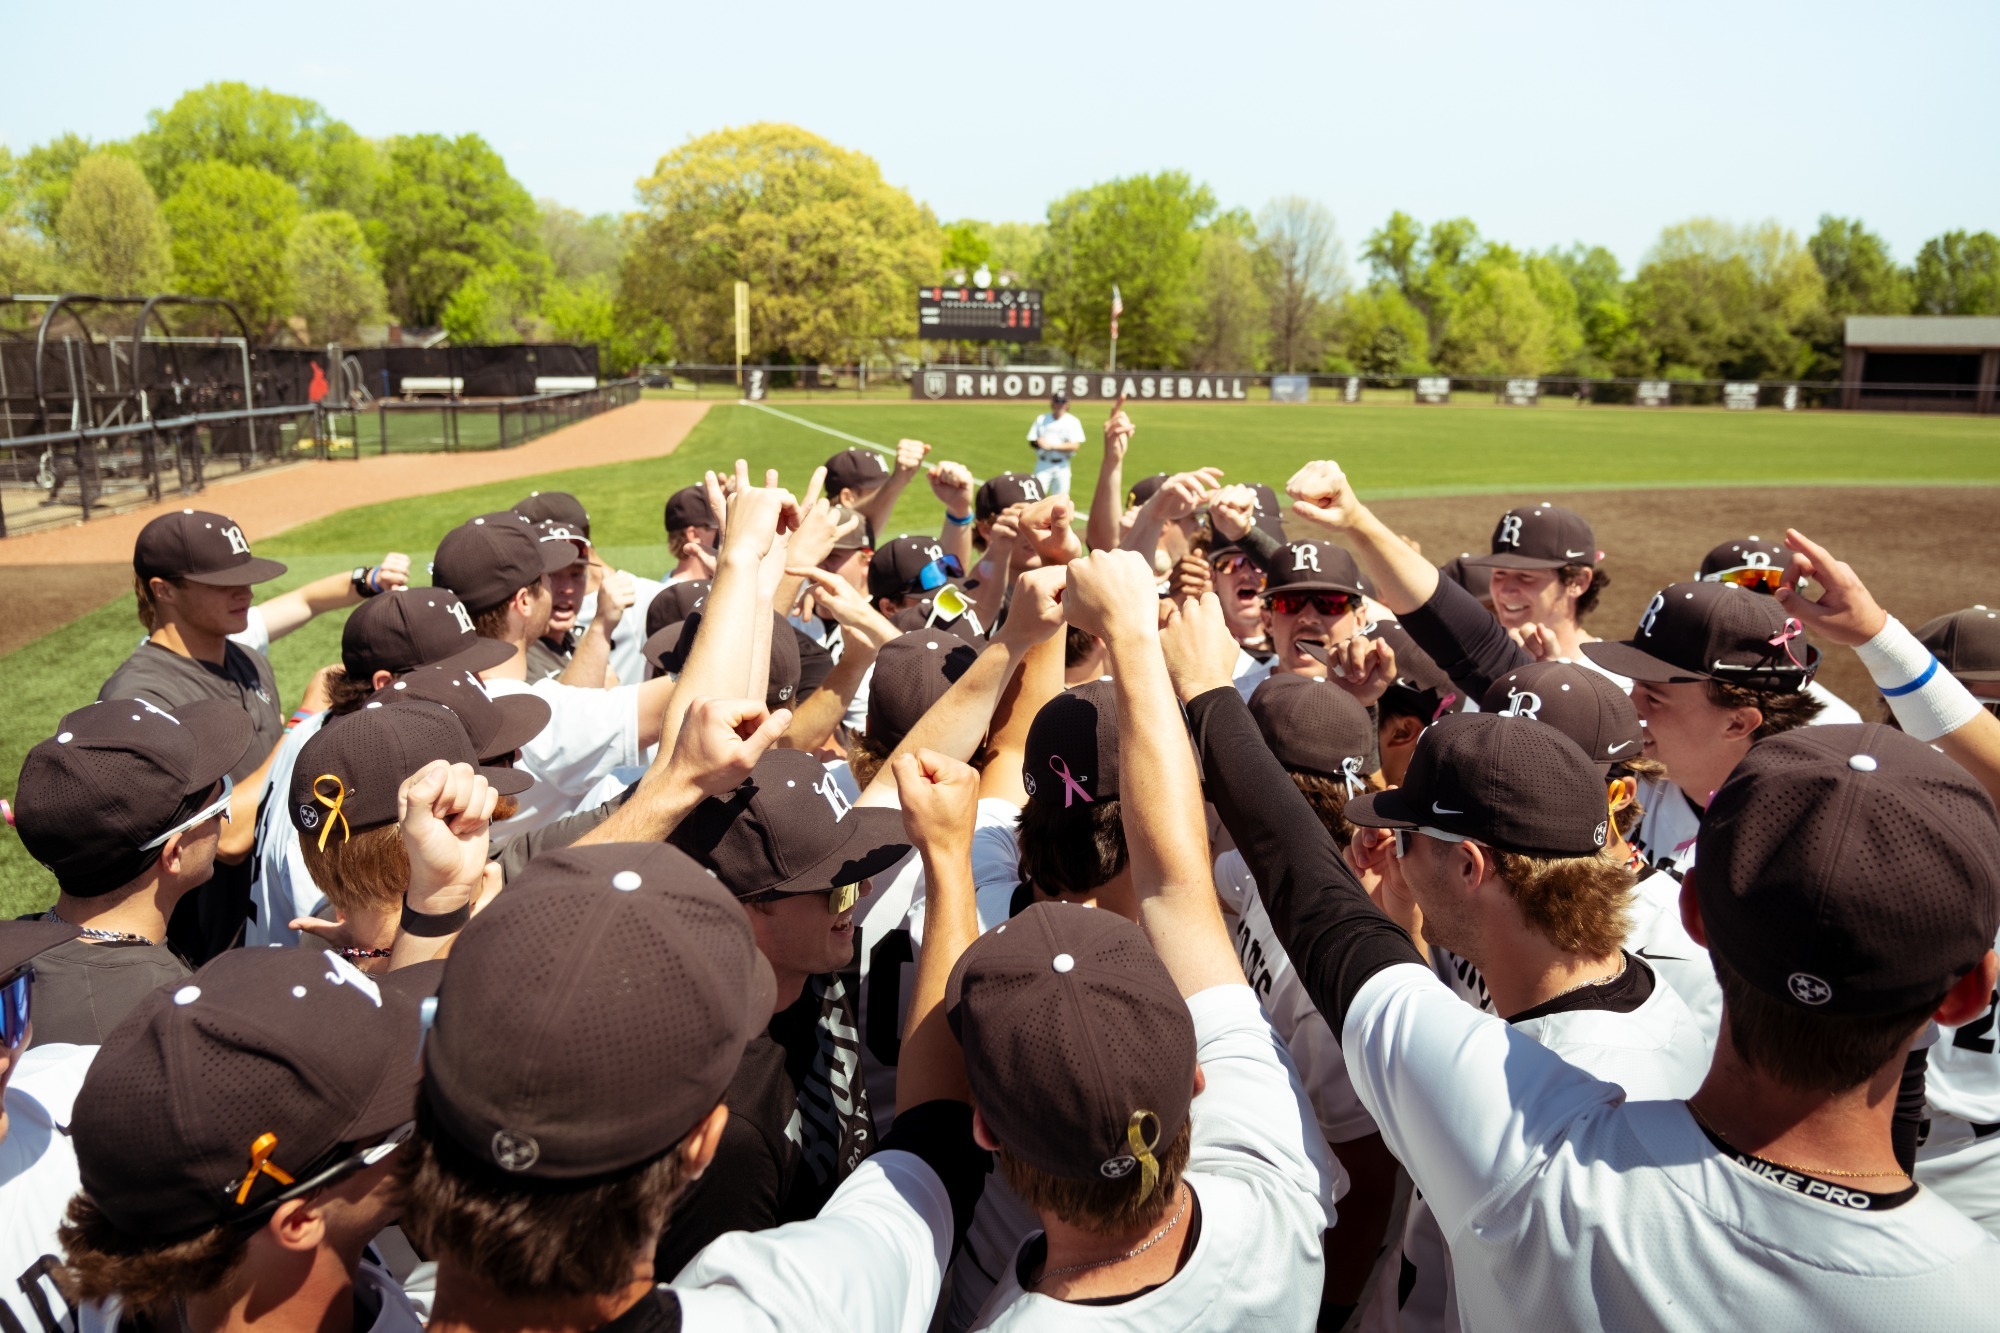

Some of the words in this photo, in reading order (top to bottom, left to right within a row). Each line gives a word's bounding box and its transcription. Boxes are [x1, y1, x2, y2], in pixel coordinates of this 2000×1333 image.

[956, 374, 1089, 397] RHODES
[1101, 376, 1246, 399] BASEBALL
[1019, 479, 1042, 502] R
[220, 525, 251, 555] R
[1498, 514, 1523, 547] R
[1291, 543, 1322, 573] R
[446, 601, 476, 635] R
[1638, 590, 1665, 638] R
[1507, 686, 1542, 721] R
[812, 772, 853, 824] R
[1735, 1154, 1804, 1192] NIKE
[1804, 1180, 1871, 1210] PRO
